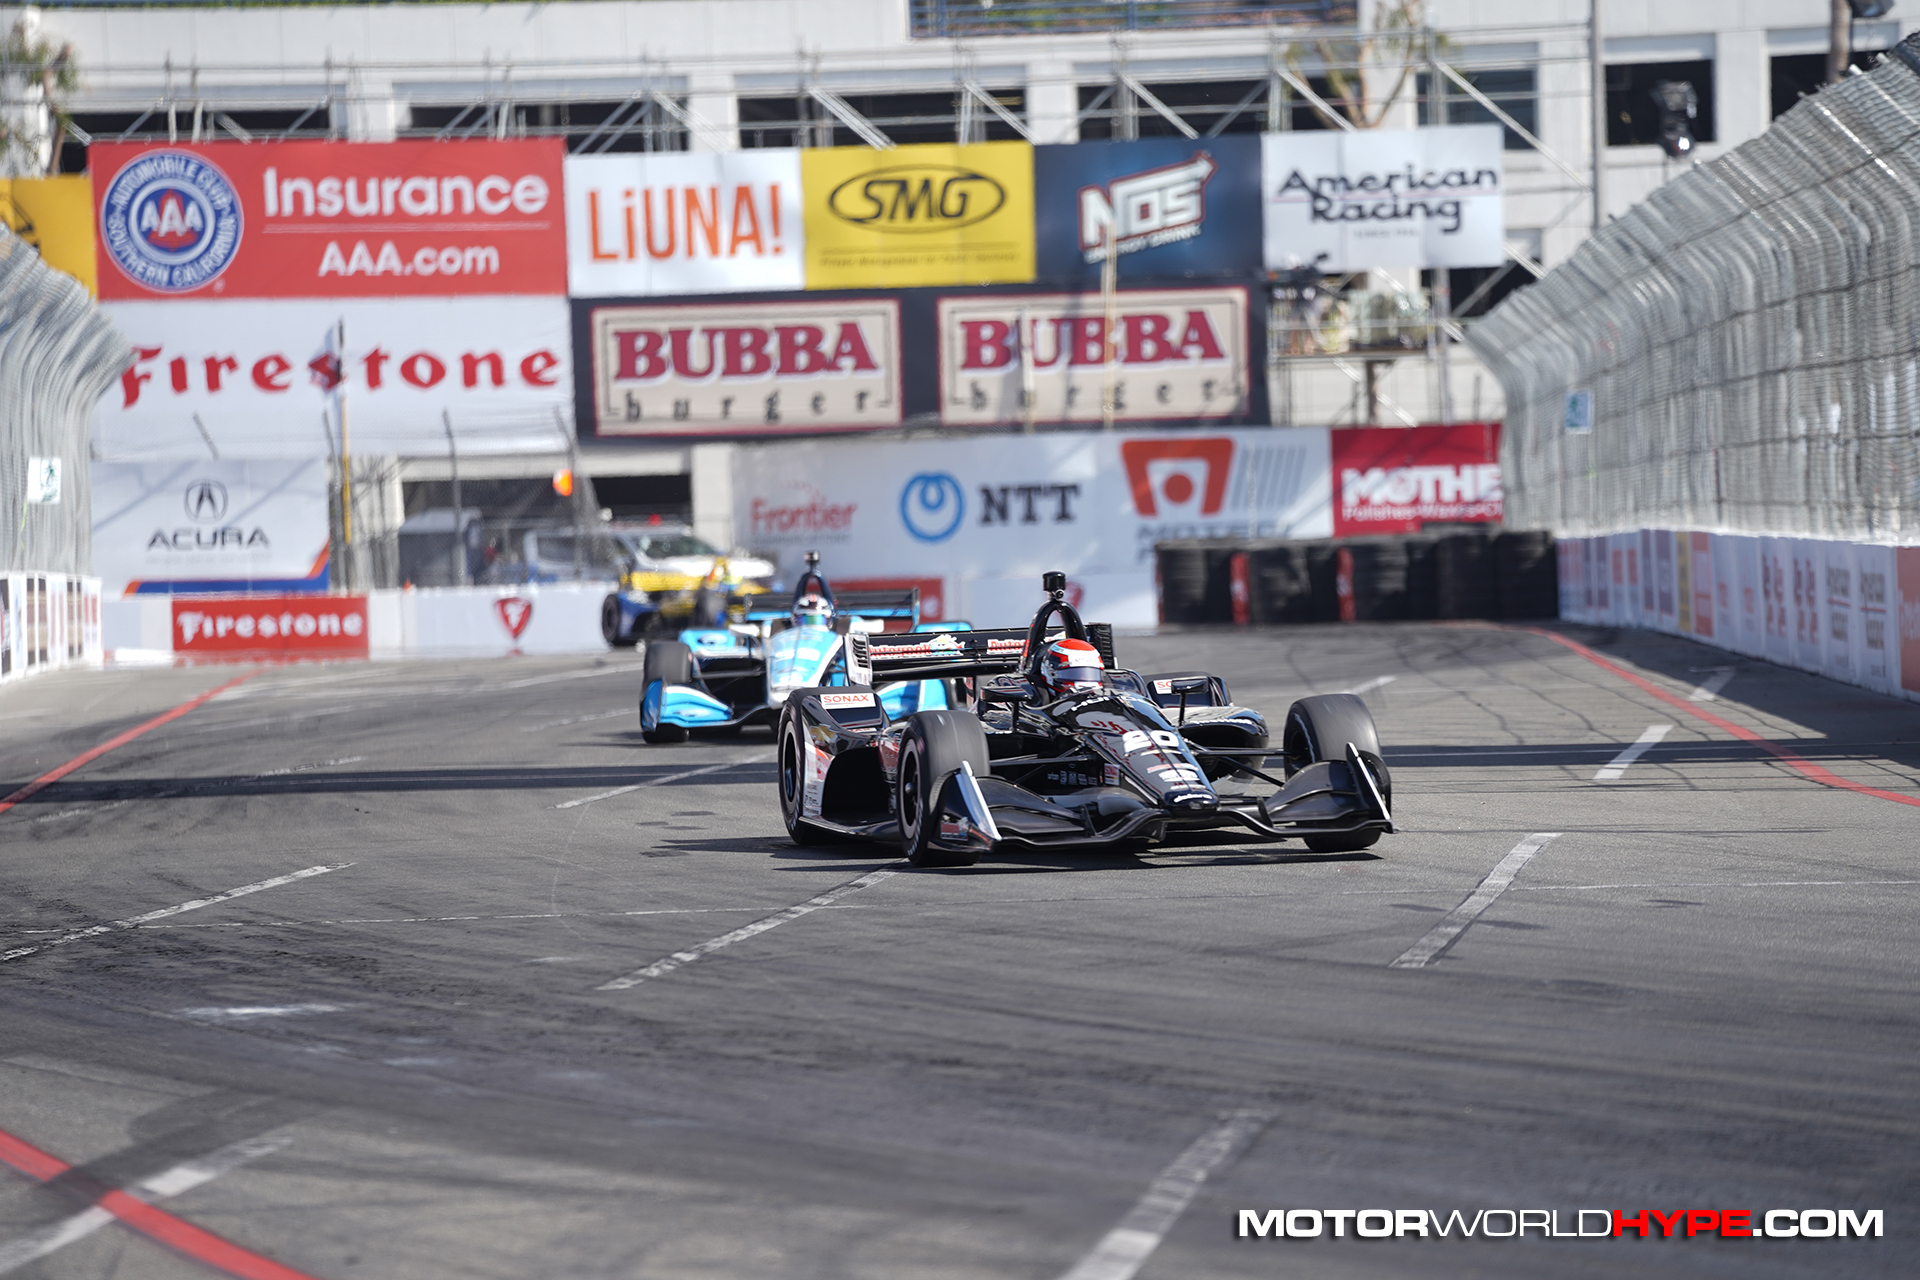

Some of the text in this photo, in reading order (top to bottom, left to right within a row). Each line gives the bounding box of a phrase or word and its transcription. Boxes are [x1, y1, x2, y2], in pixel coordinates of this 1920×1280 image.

[263, 166, 550, 217] Insurance
[854, 175, 987, 223] SMG
[1277, 163, 1498, 196] American
[140, 198, 204, 238] AAA
[1080, 155, 1215, 247] NOS
[1310, 195, 1462, 234] Racing
[587, 183, 785, 262] LiUNA!
[318, 240, 500, 277] AAA.com
[613, 322, 878, 381] BUBBA
[960, 311, 1226, 370] BUBBA
[122, 344, 560, 410] Firetone
[624, 390, 873, 424] burger
[751, 496, 858, 533] Frontier
[978, 483, 1081, 527] NTT
[147, 527, 271, 551] ACURA
[176, 610, 365, 646] Firestone
[823, 694, 870, 704] SONAX
